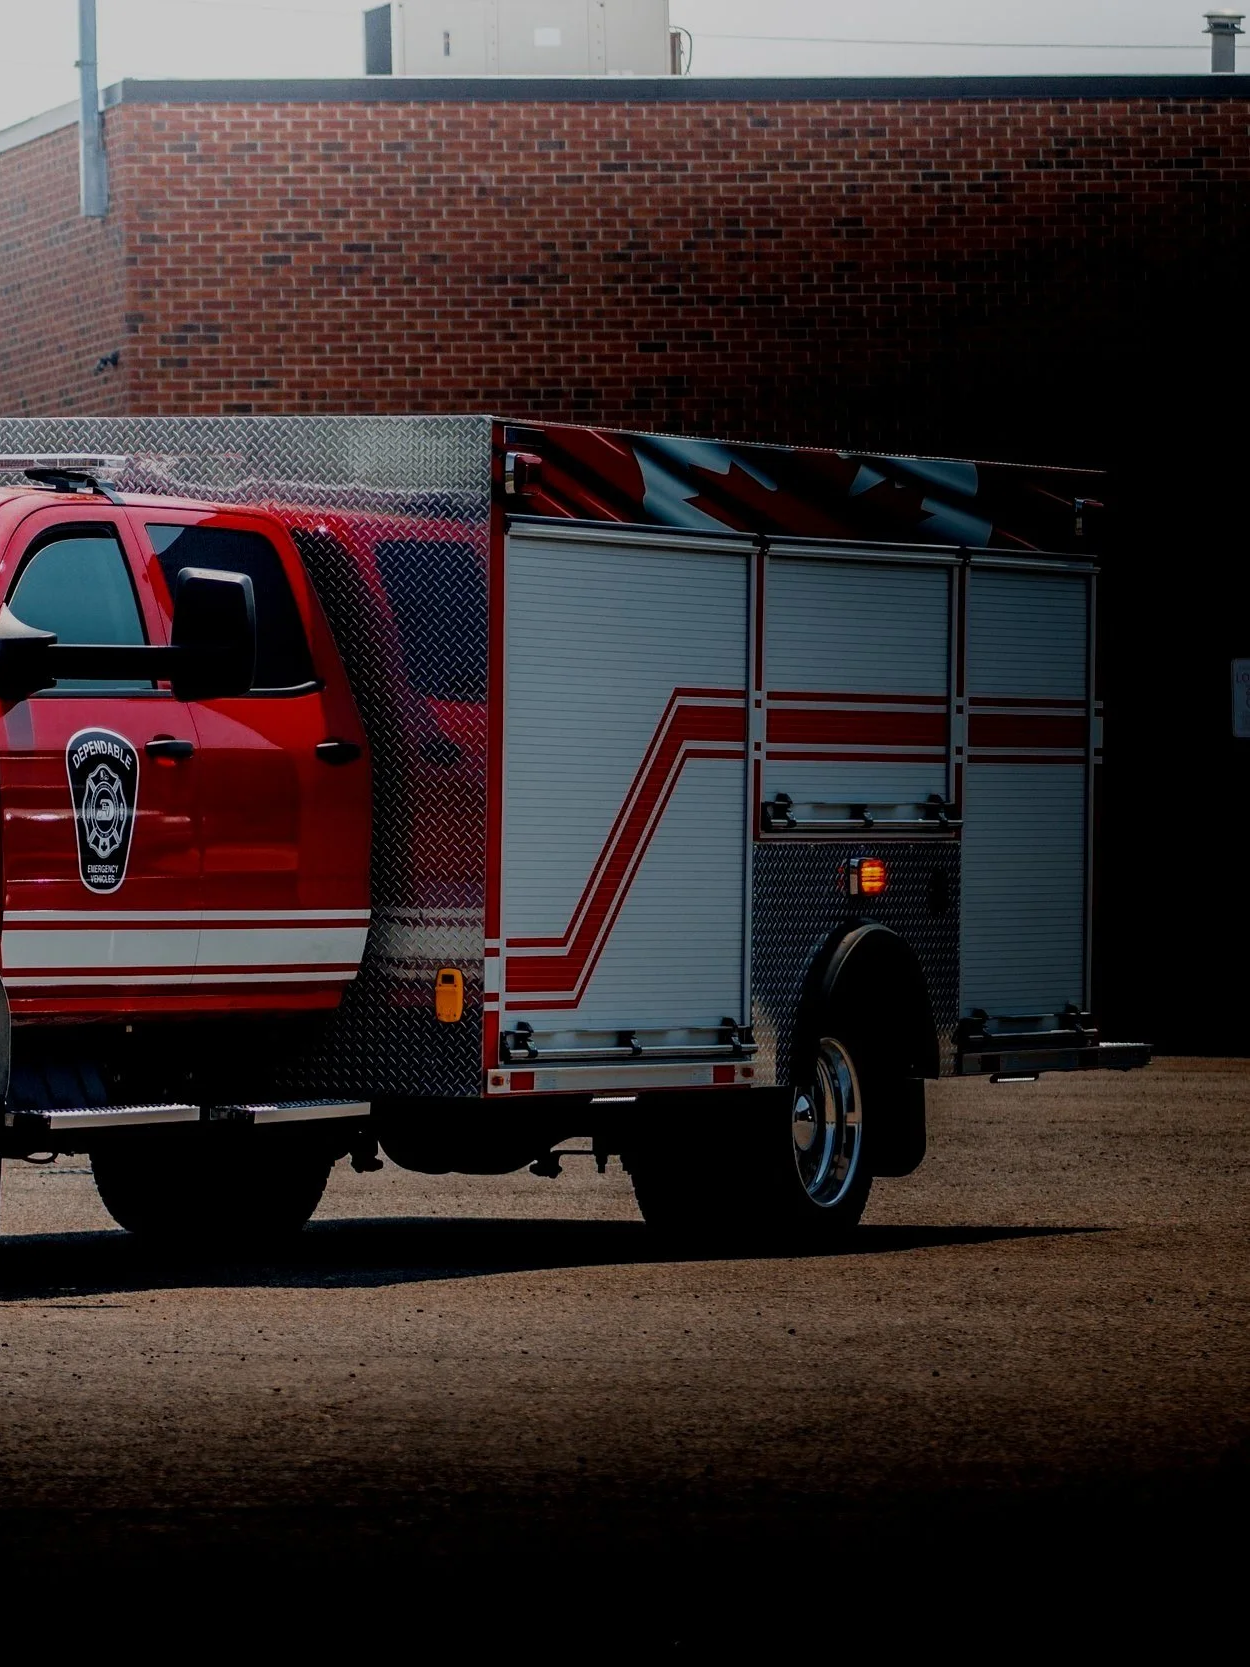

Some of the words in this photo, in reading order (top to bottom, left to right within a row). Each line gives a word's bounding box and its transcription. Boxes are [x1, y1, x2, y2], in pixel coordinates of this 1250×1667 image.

[72, 740, 133, 771] DEPENDABLE
[87, 864, 119, 874] EMERGENCY
[90, 874, 116, 884] VEHICLES
